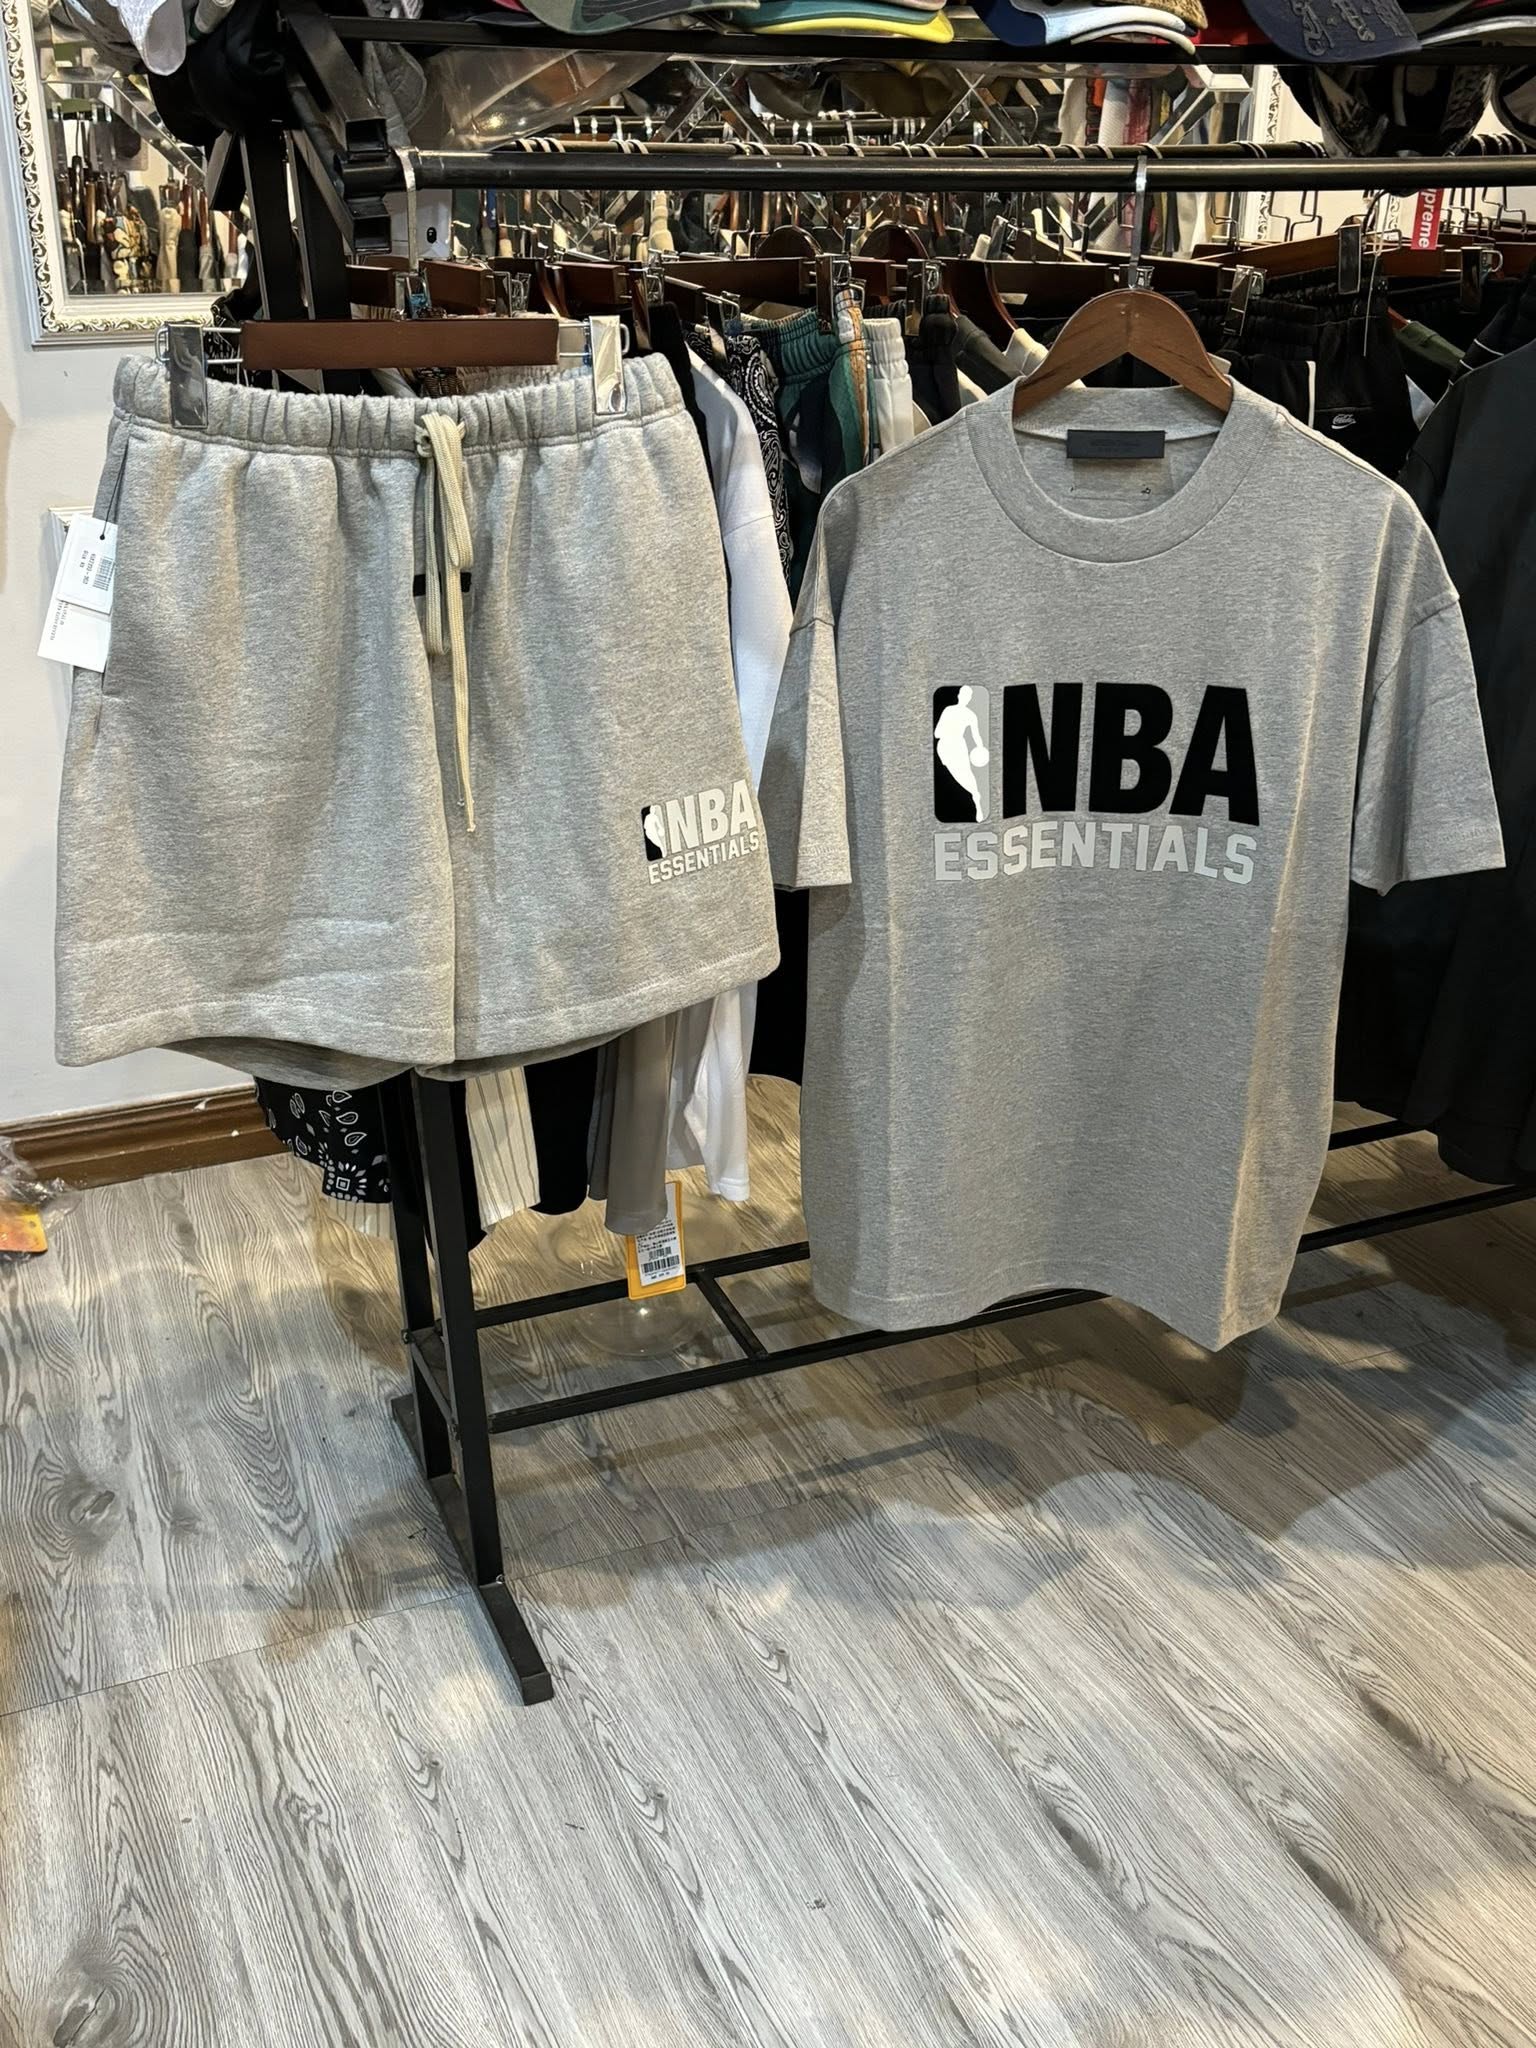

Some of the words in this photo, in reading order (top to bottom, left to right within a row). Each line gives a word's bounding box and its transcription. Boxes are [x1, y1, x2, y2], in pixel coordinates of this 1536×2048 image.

[1418, 188, 1437, 248] preme
[1003, 682, 1260, 826] NBA
[665, 779, 757, 854] NBA
[648, 831, 759, 885] ESSENTIALS
[934, 821, 1257, 885] ESSENTIALS
